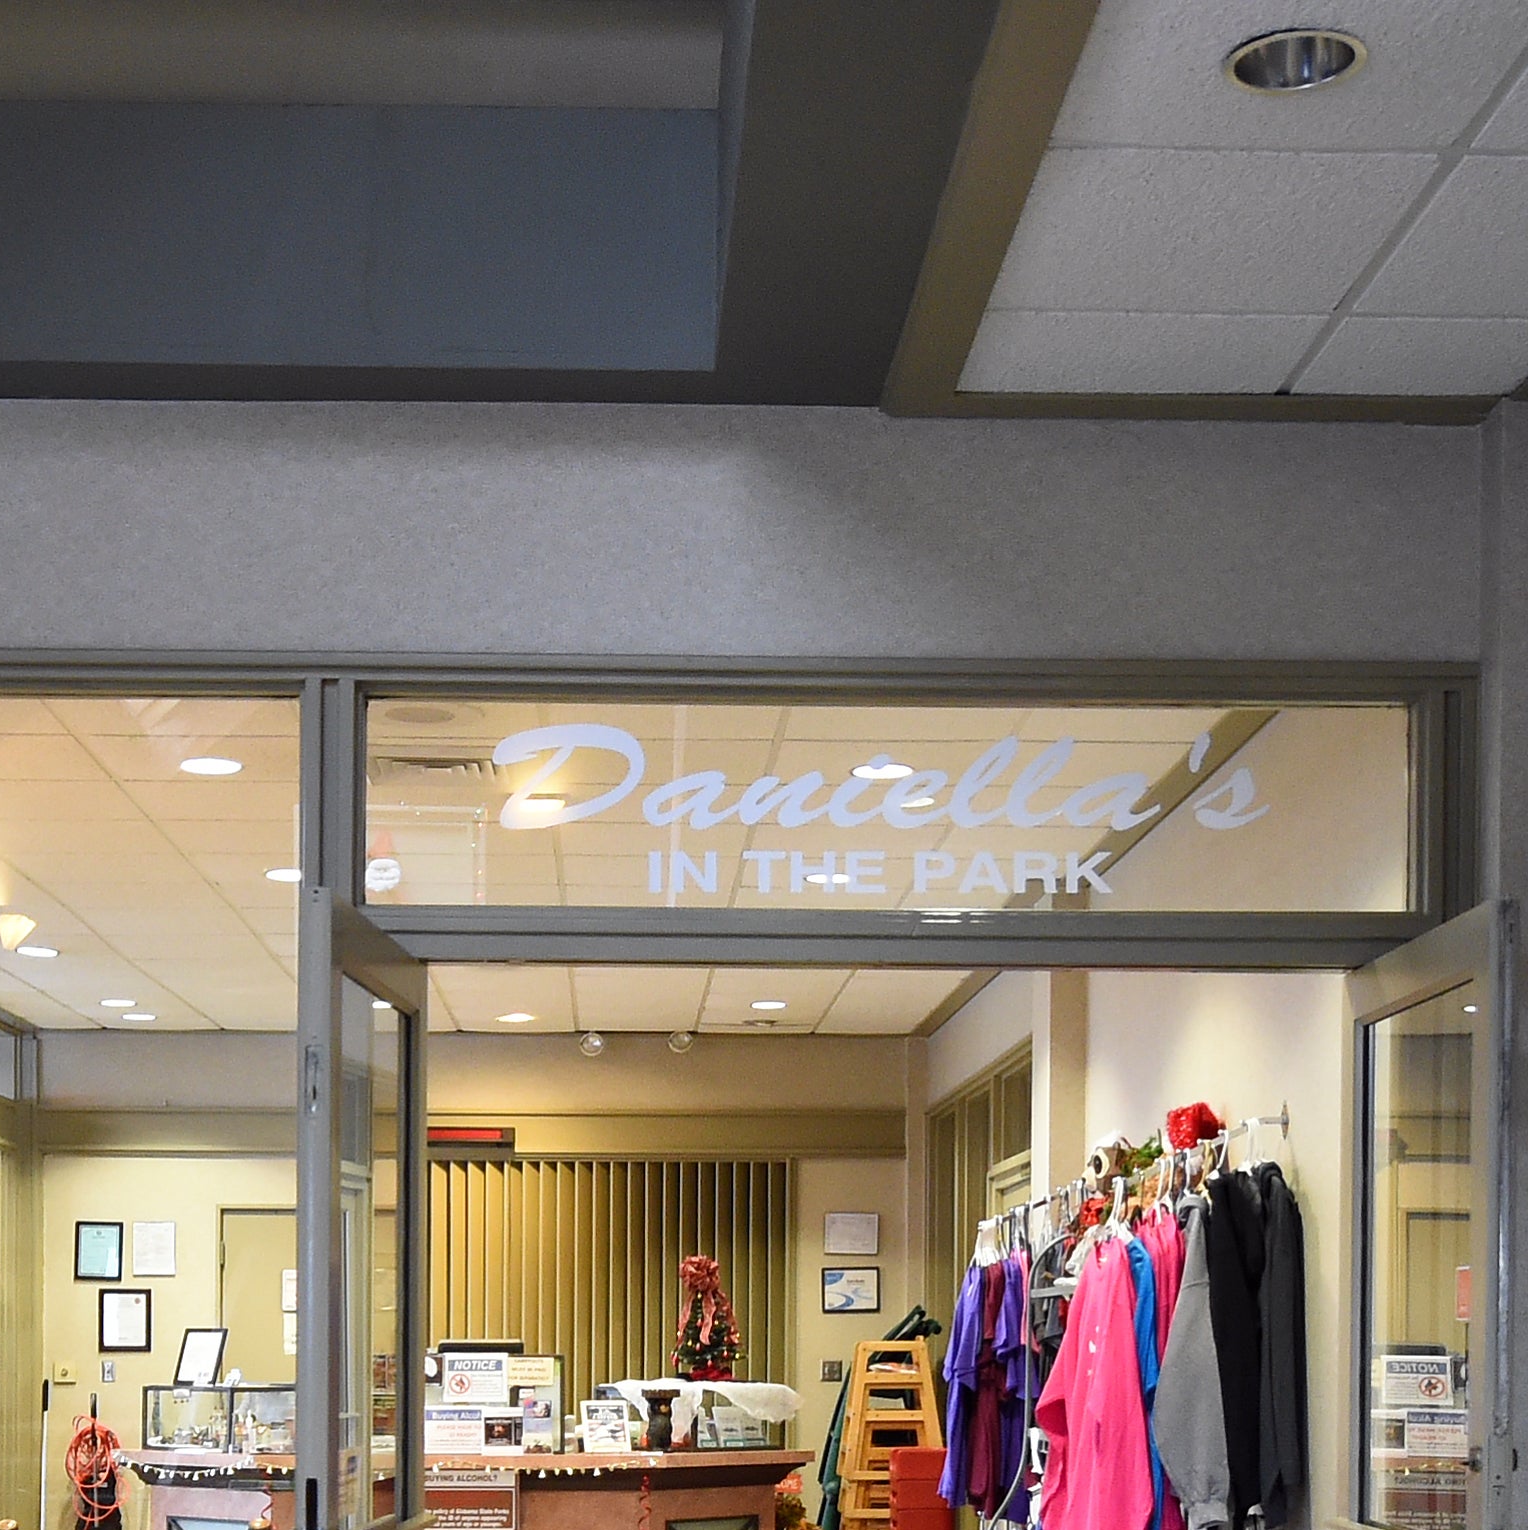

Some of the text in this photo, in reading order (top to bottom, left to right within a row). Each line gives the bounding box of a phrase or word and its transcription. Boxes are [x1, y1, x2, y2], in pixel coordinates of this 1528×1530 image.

[492, 723, 1271, 830] Daniella's
[649, 850, 1114, 896] IN THE PARK
[453, 1360, 498, 1371] NOTICE
